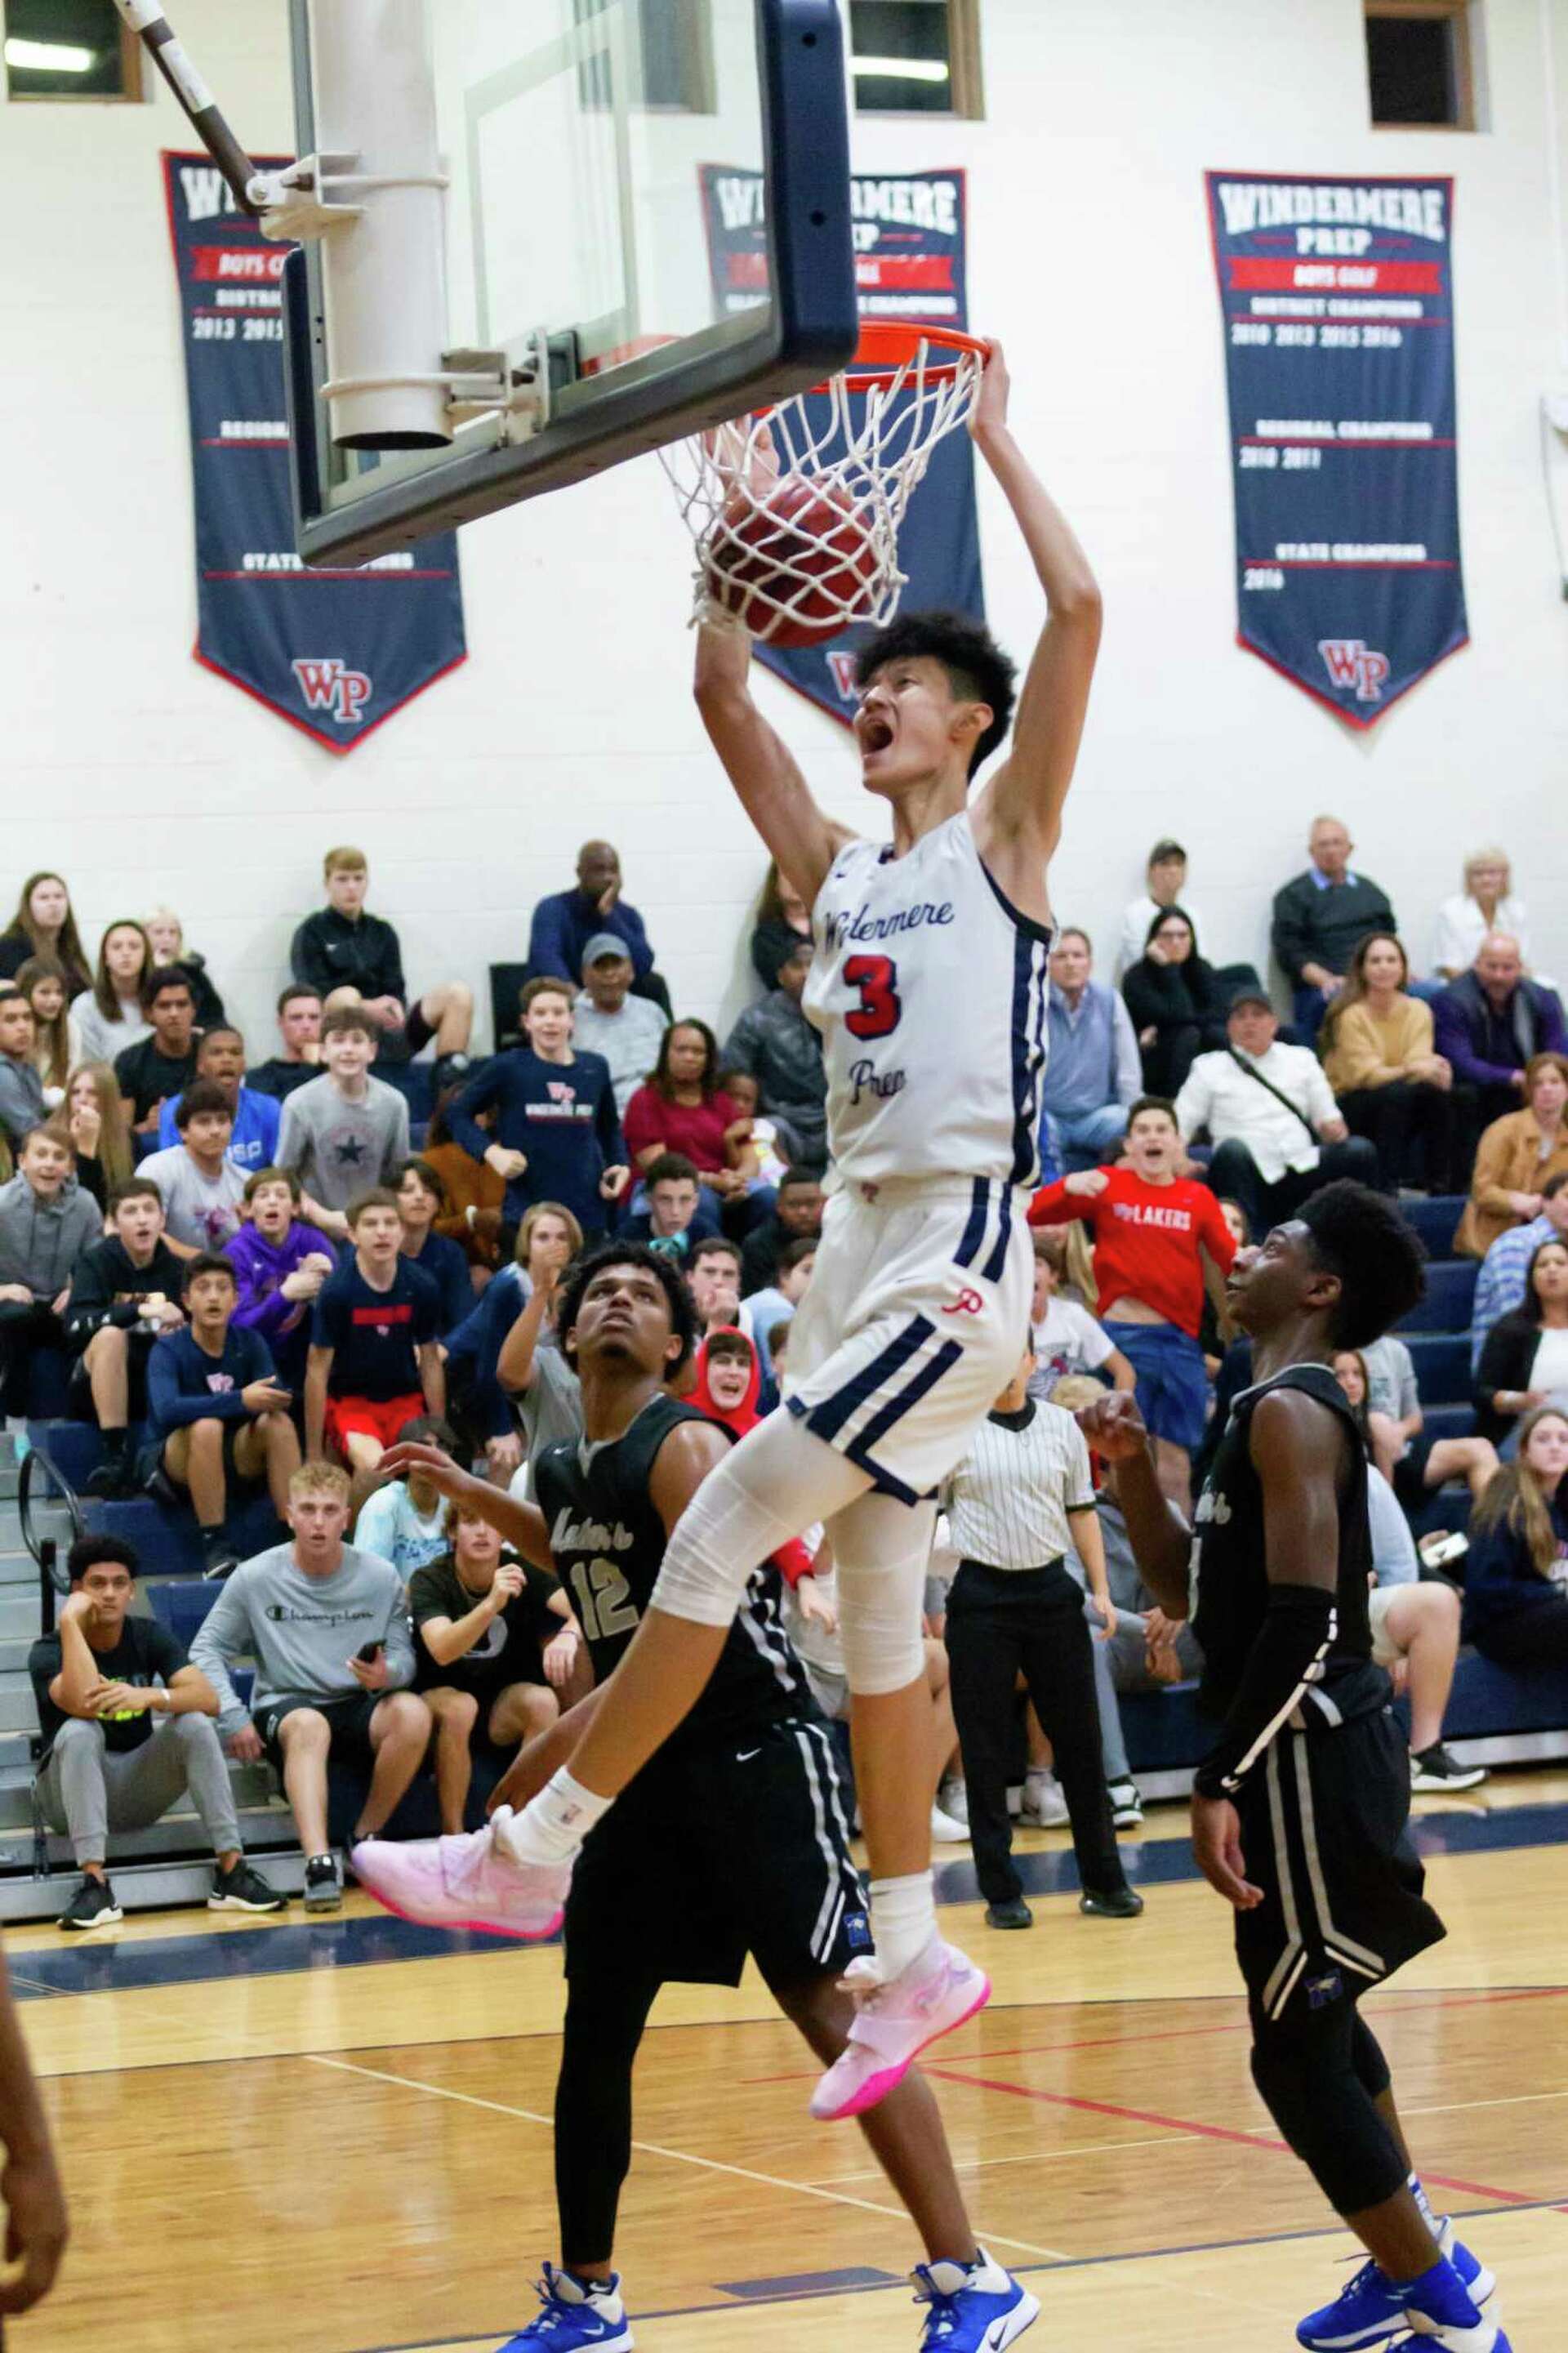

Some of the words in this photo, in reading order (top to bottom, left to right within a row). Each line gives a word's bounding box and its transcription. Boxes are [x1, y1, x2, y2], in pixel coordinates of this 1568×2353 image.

[1218, 183, 1446, 243] WINDERMERE
[1295, 227, 1372, 256] PREP
[218, 252, 265, 276] BOYS
[193, 317, 236, 341] 2013
[1275, 542, 1330, 562] STATE
[291, 658, 372, 724] WP
[1317, 639, 1391, 702] WP
[843, 954, 902, 1041] 3
[265, 1604, 374, 1628] Champion
[569, 1557, 641, 1642] 12
